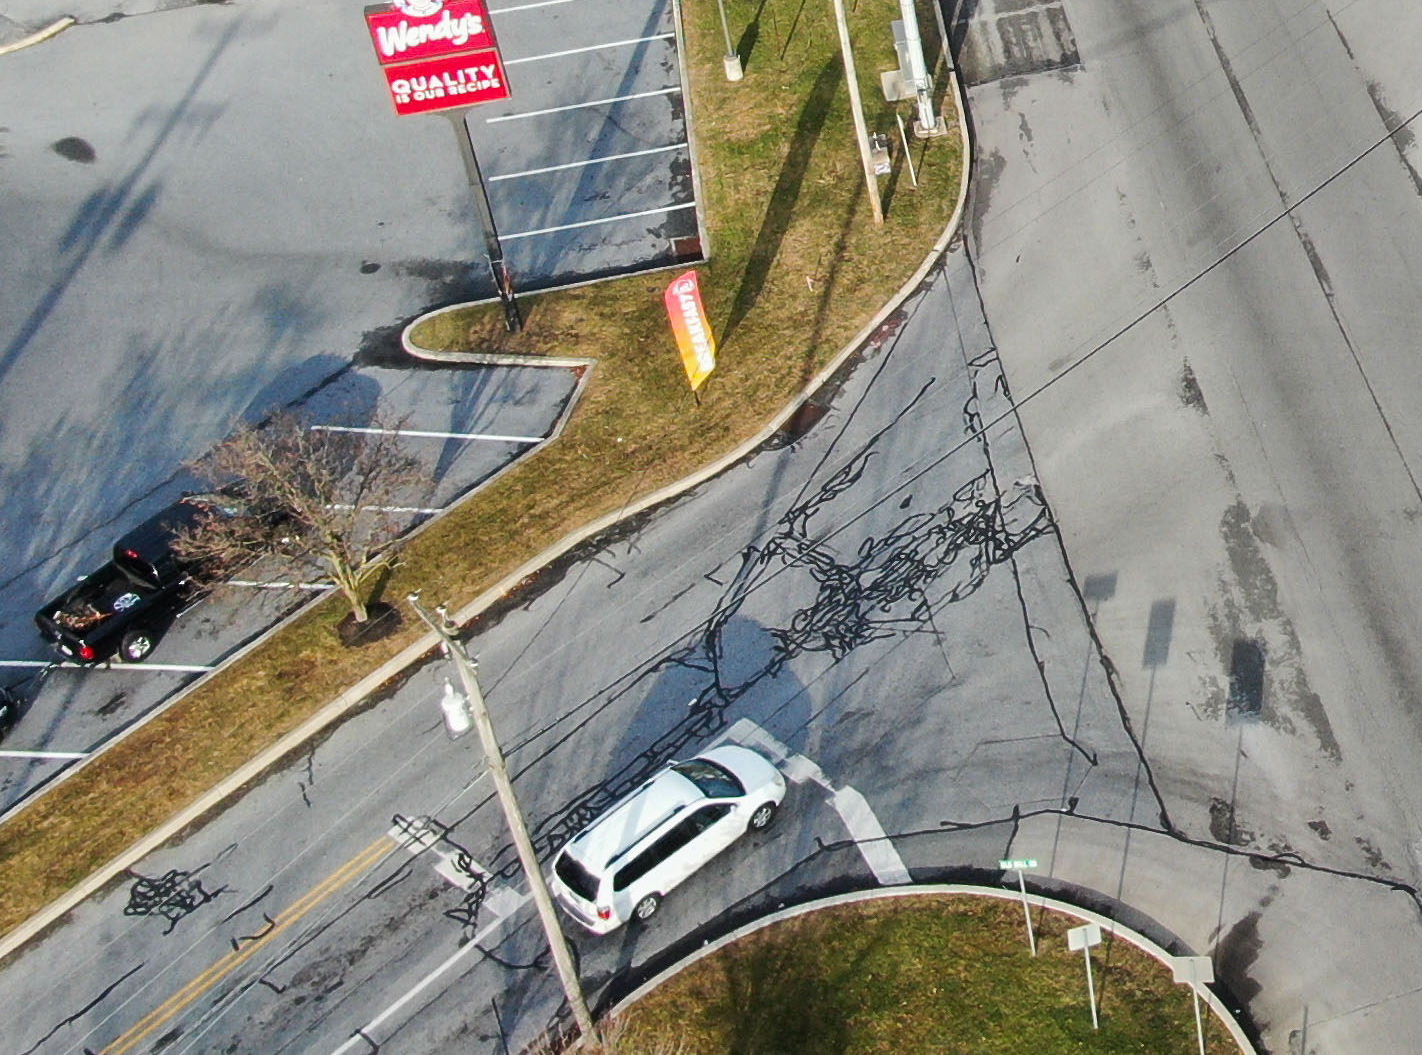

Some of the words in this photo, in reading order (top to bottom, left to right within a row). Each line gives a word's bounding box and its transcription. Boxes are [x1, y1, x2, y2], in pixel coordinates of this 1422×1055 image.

[377, 10, 484, 56] Wendy's
[392, 64, 496, 94] QUALITY
[396, 93, 411, 104] IS
[414, 87, 445, 101] OUR
[448, 78, 500, 95] RECIPE
